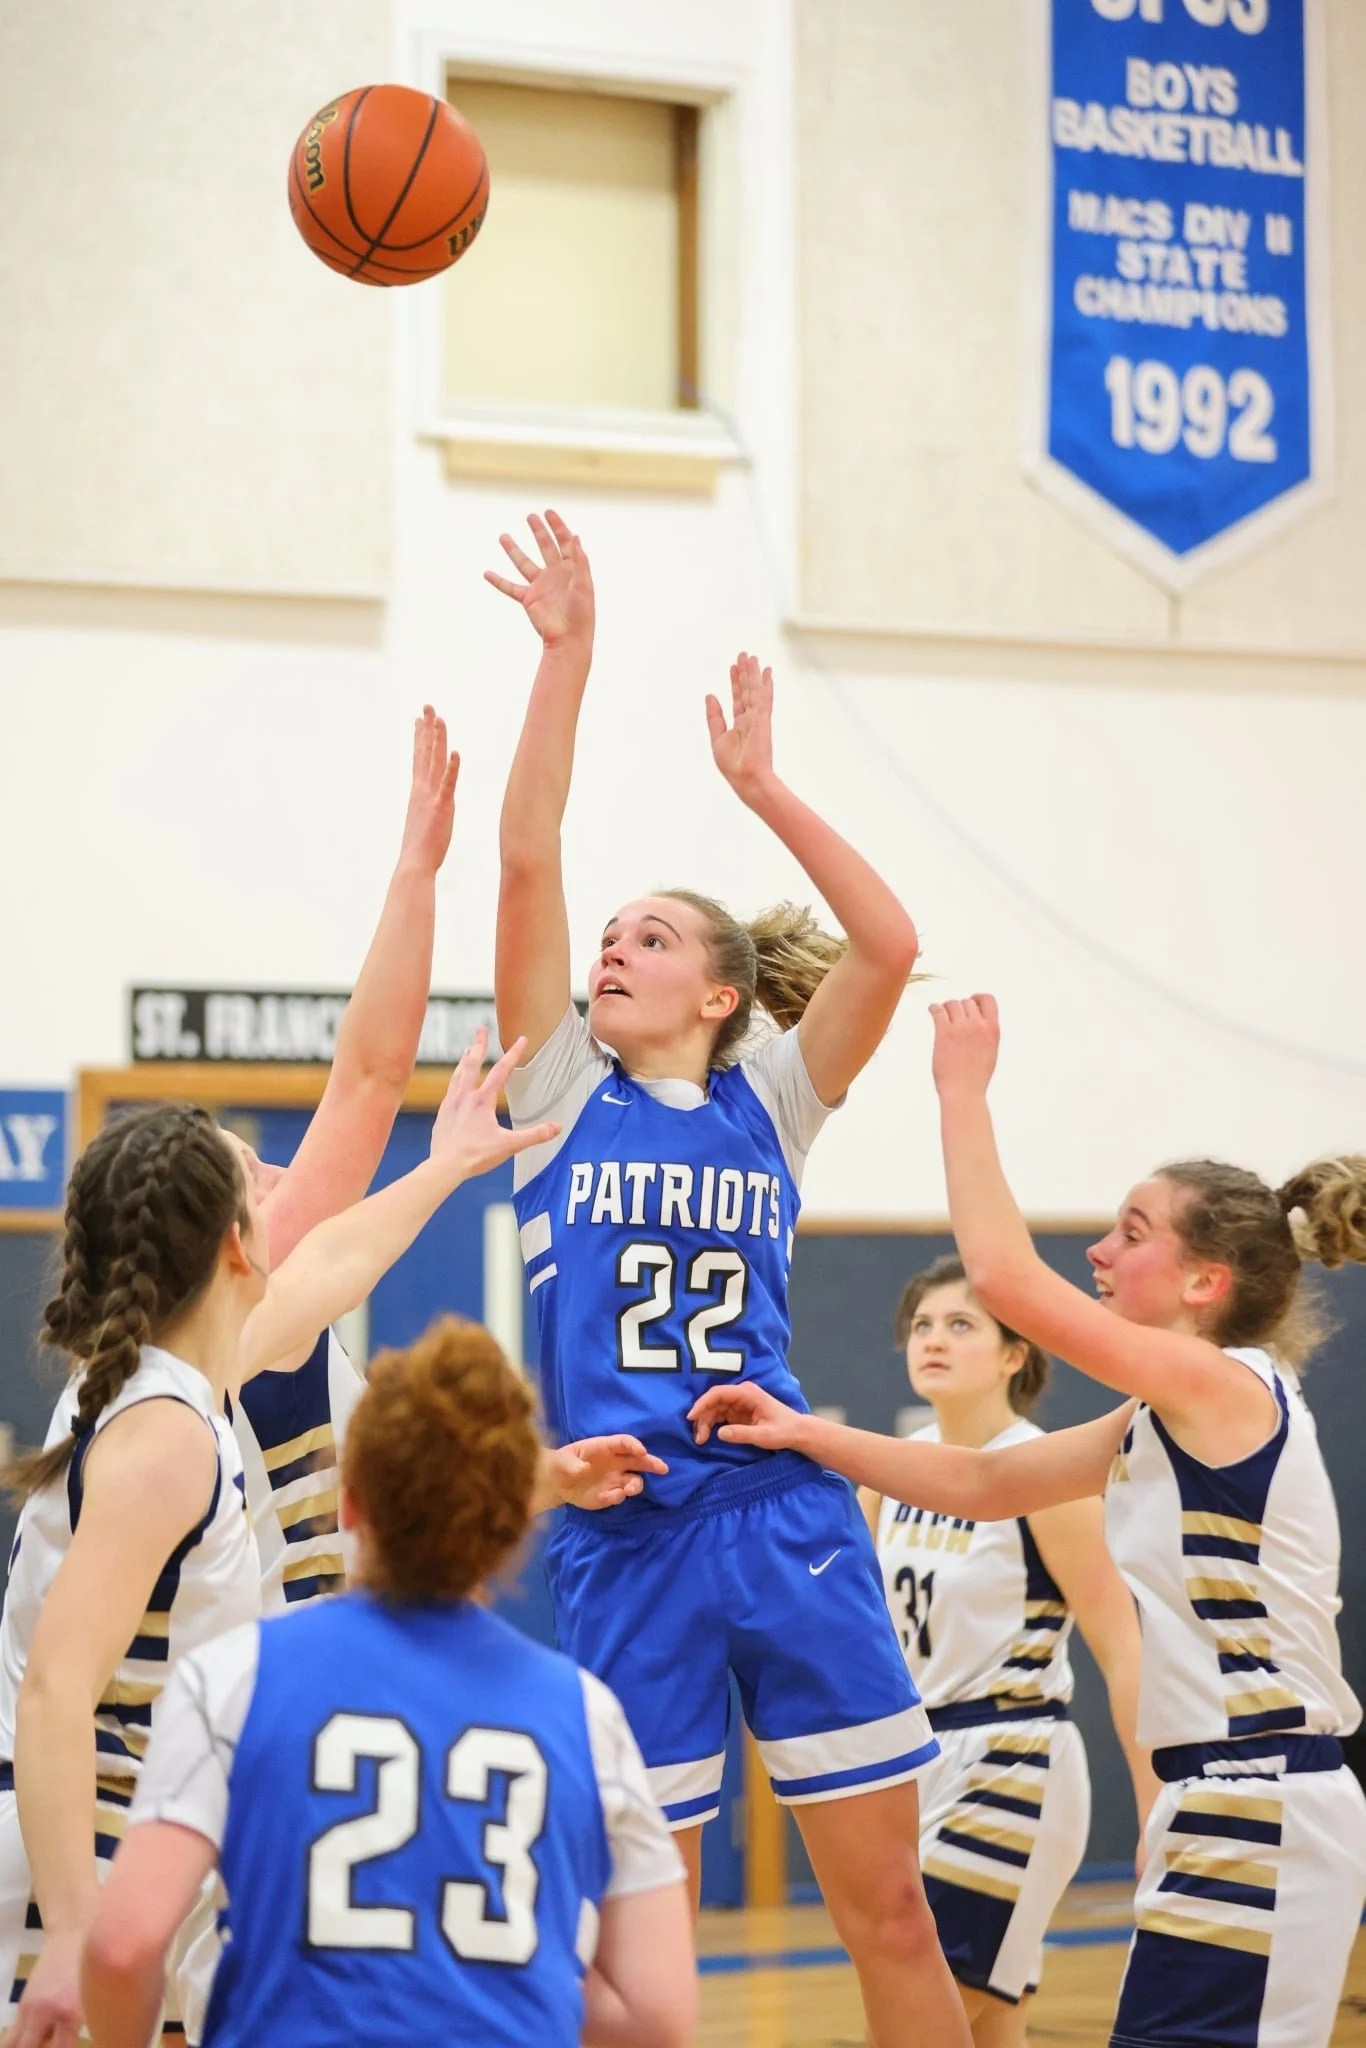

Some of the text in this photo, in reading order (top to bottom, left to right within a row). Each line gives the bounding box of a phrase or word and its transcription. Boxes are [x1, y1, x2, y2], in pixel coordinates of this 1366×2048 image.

[1126, 57, 1238, 116] BOYS
[1053, 98, 1304, 177] BASKETBALL
[1068, 188, 1174, 241] MACS
[1184, 201, 1249, 250] DIV
[1116, 239, 1248, 291] STATE
[1073, 273, 1288, 337] CHAMPIONS
[1105, 355, 1278, 464] 1992
[136, 992, 199, 1059] ST.
[205, 993, 349, 1062] FRANC
[565, 1160, 782, 1240] PATRIOTS
[615, 1239, 750, 1373] 22
[895, 1565, 938, 1659] 31
[307, 1707, 549, 1968] 23
